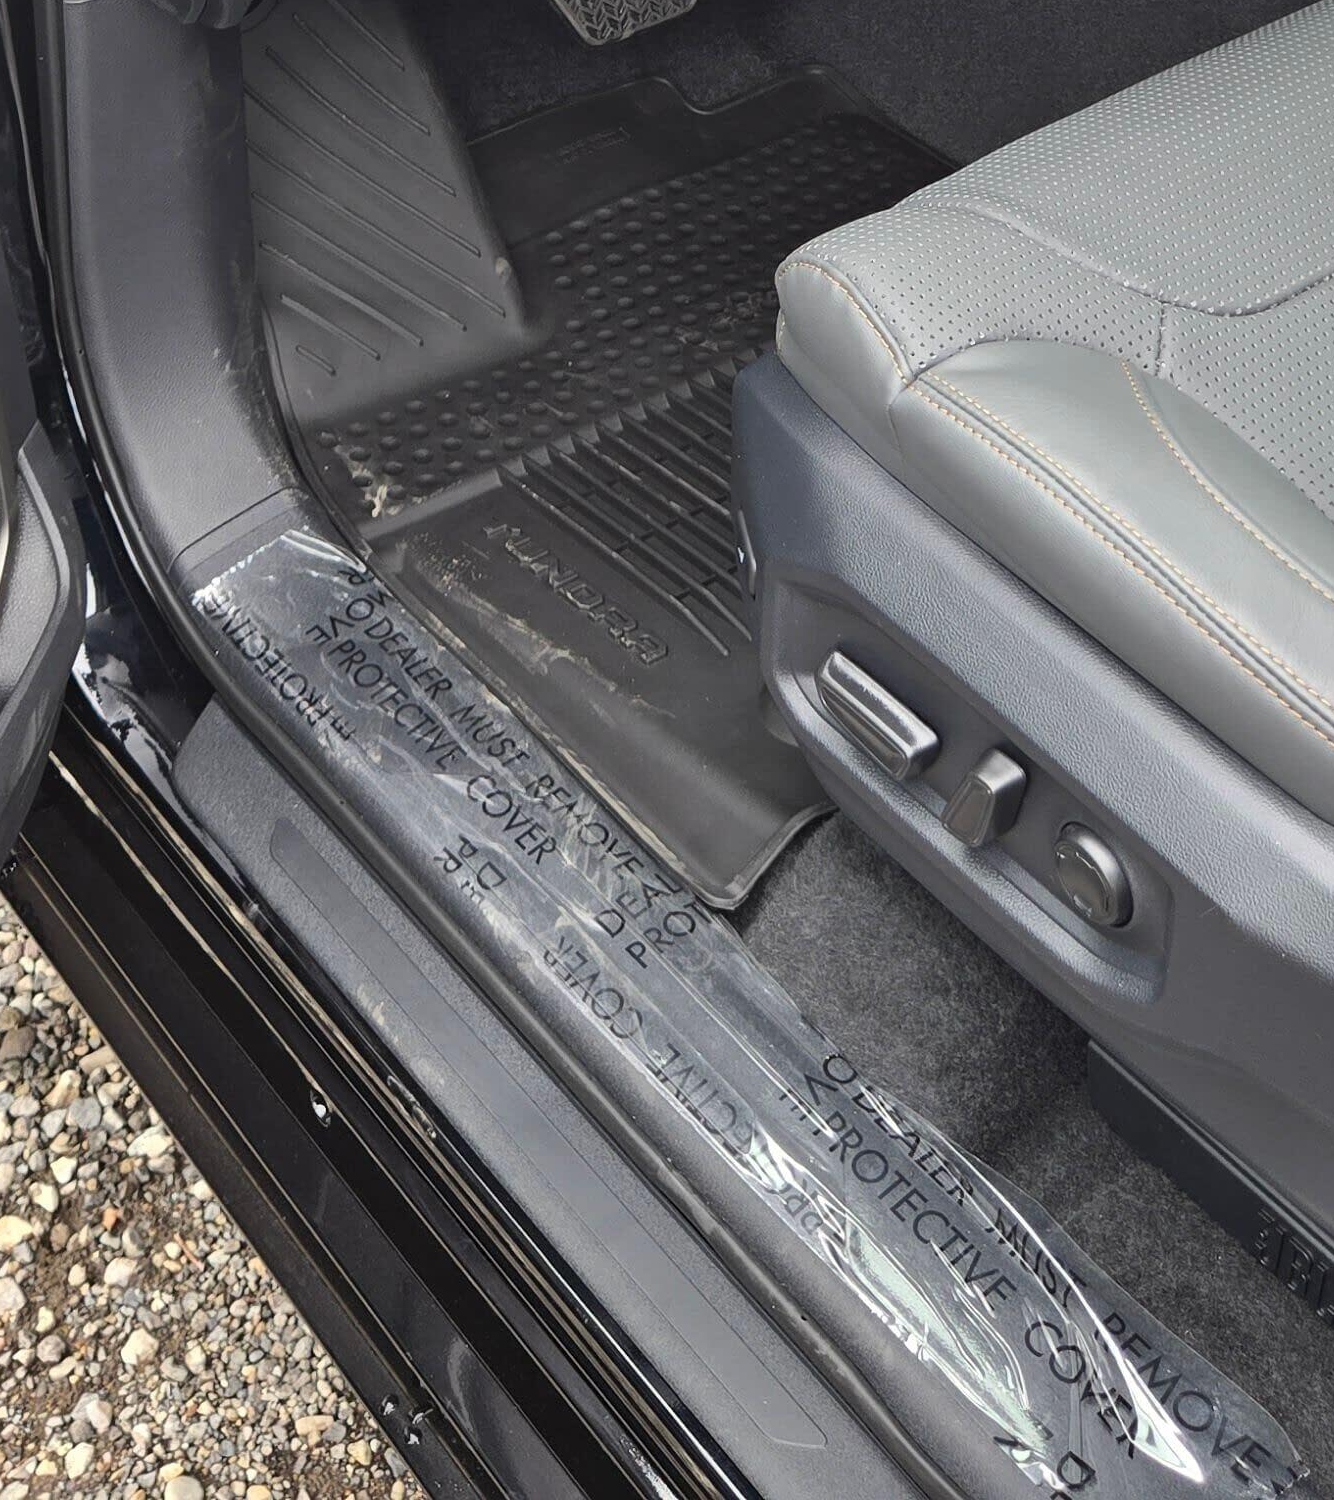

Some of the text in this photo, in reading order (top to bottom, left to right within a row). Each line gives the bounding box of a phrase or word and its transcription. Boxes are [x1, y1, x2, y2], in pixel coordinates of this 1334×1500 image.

[483, 523, 669, 666] TUNDRA
[328, 638, 468, 771] PROTECTIVE
[466, 774, 558, 866] COVER
[363, 616, 453, 701] DEALER
[450, 702, 531, 768] MUST
[524, 773, 645, 877] REMOVE
[812, 1109, 1018, 1312] PROTECTIVE
